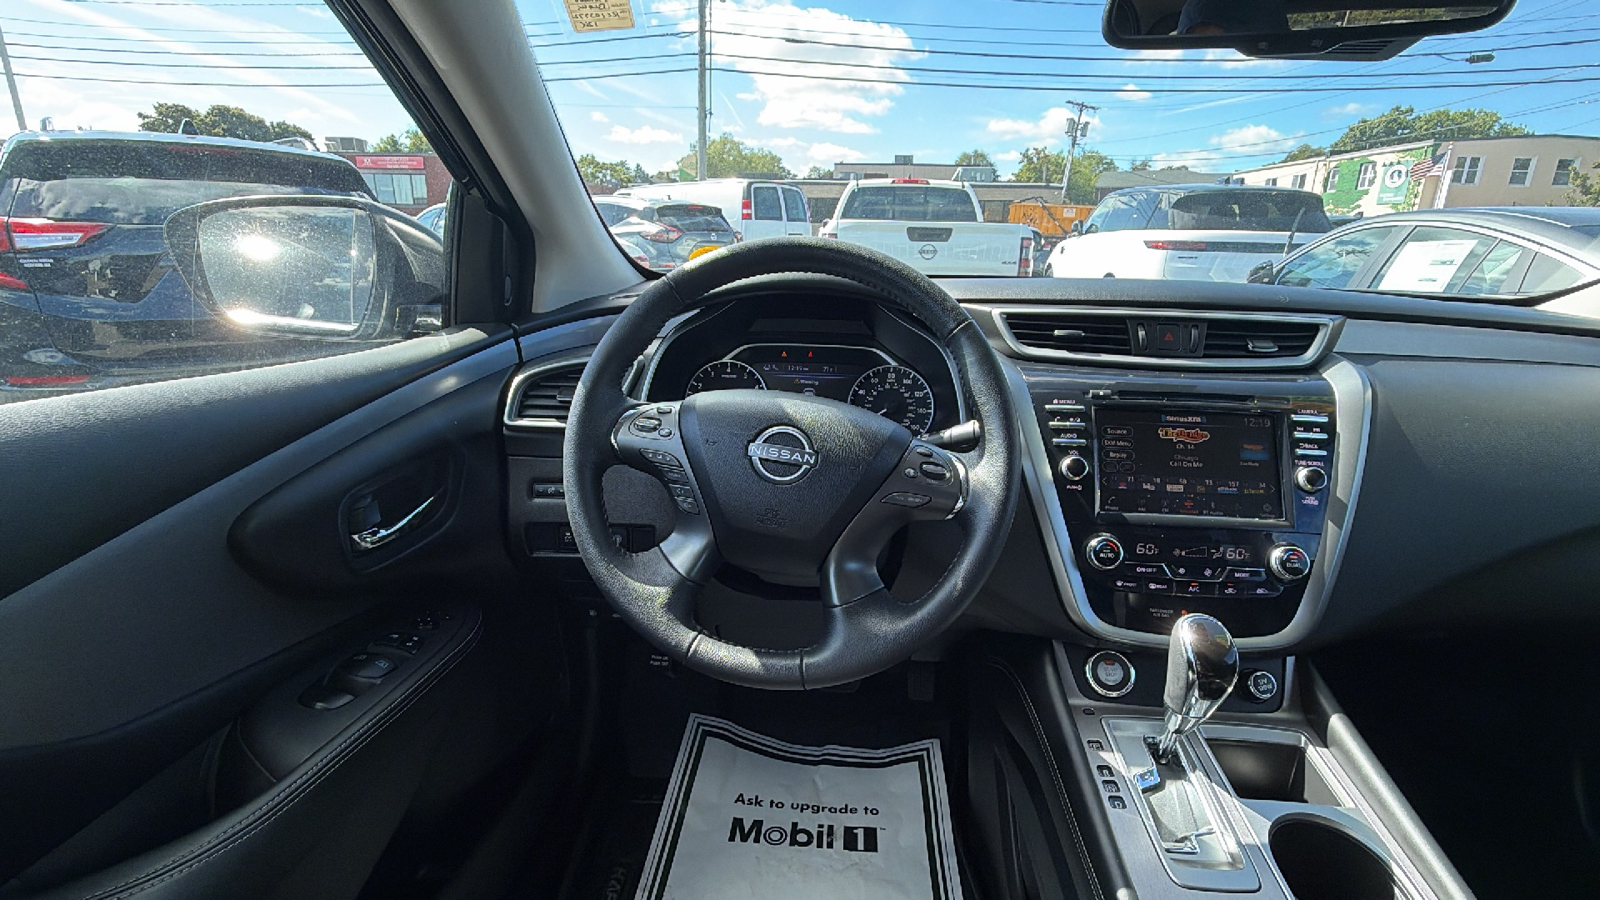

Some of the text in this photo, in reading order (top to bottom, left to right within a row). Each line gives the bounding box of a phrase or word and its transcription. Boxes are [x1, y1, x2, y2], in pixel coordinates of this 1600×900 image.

[1243, 416, 1271, 428] 12:19
[750, 446, 816, 464] NISSAN
[733, 793, 880, 816] Ask to upgrade to
[727, 816, 835, 850] Mobil
